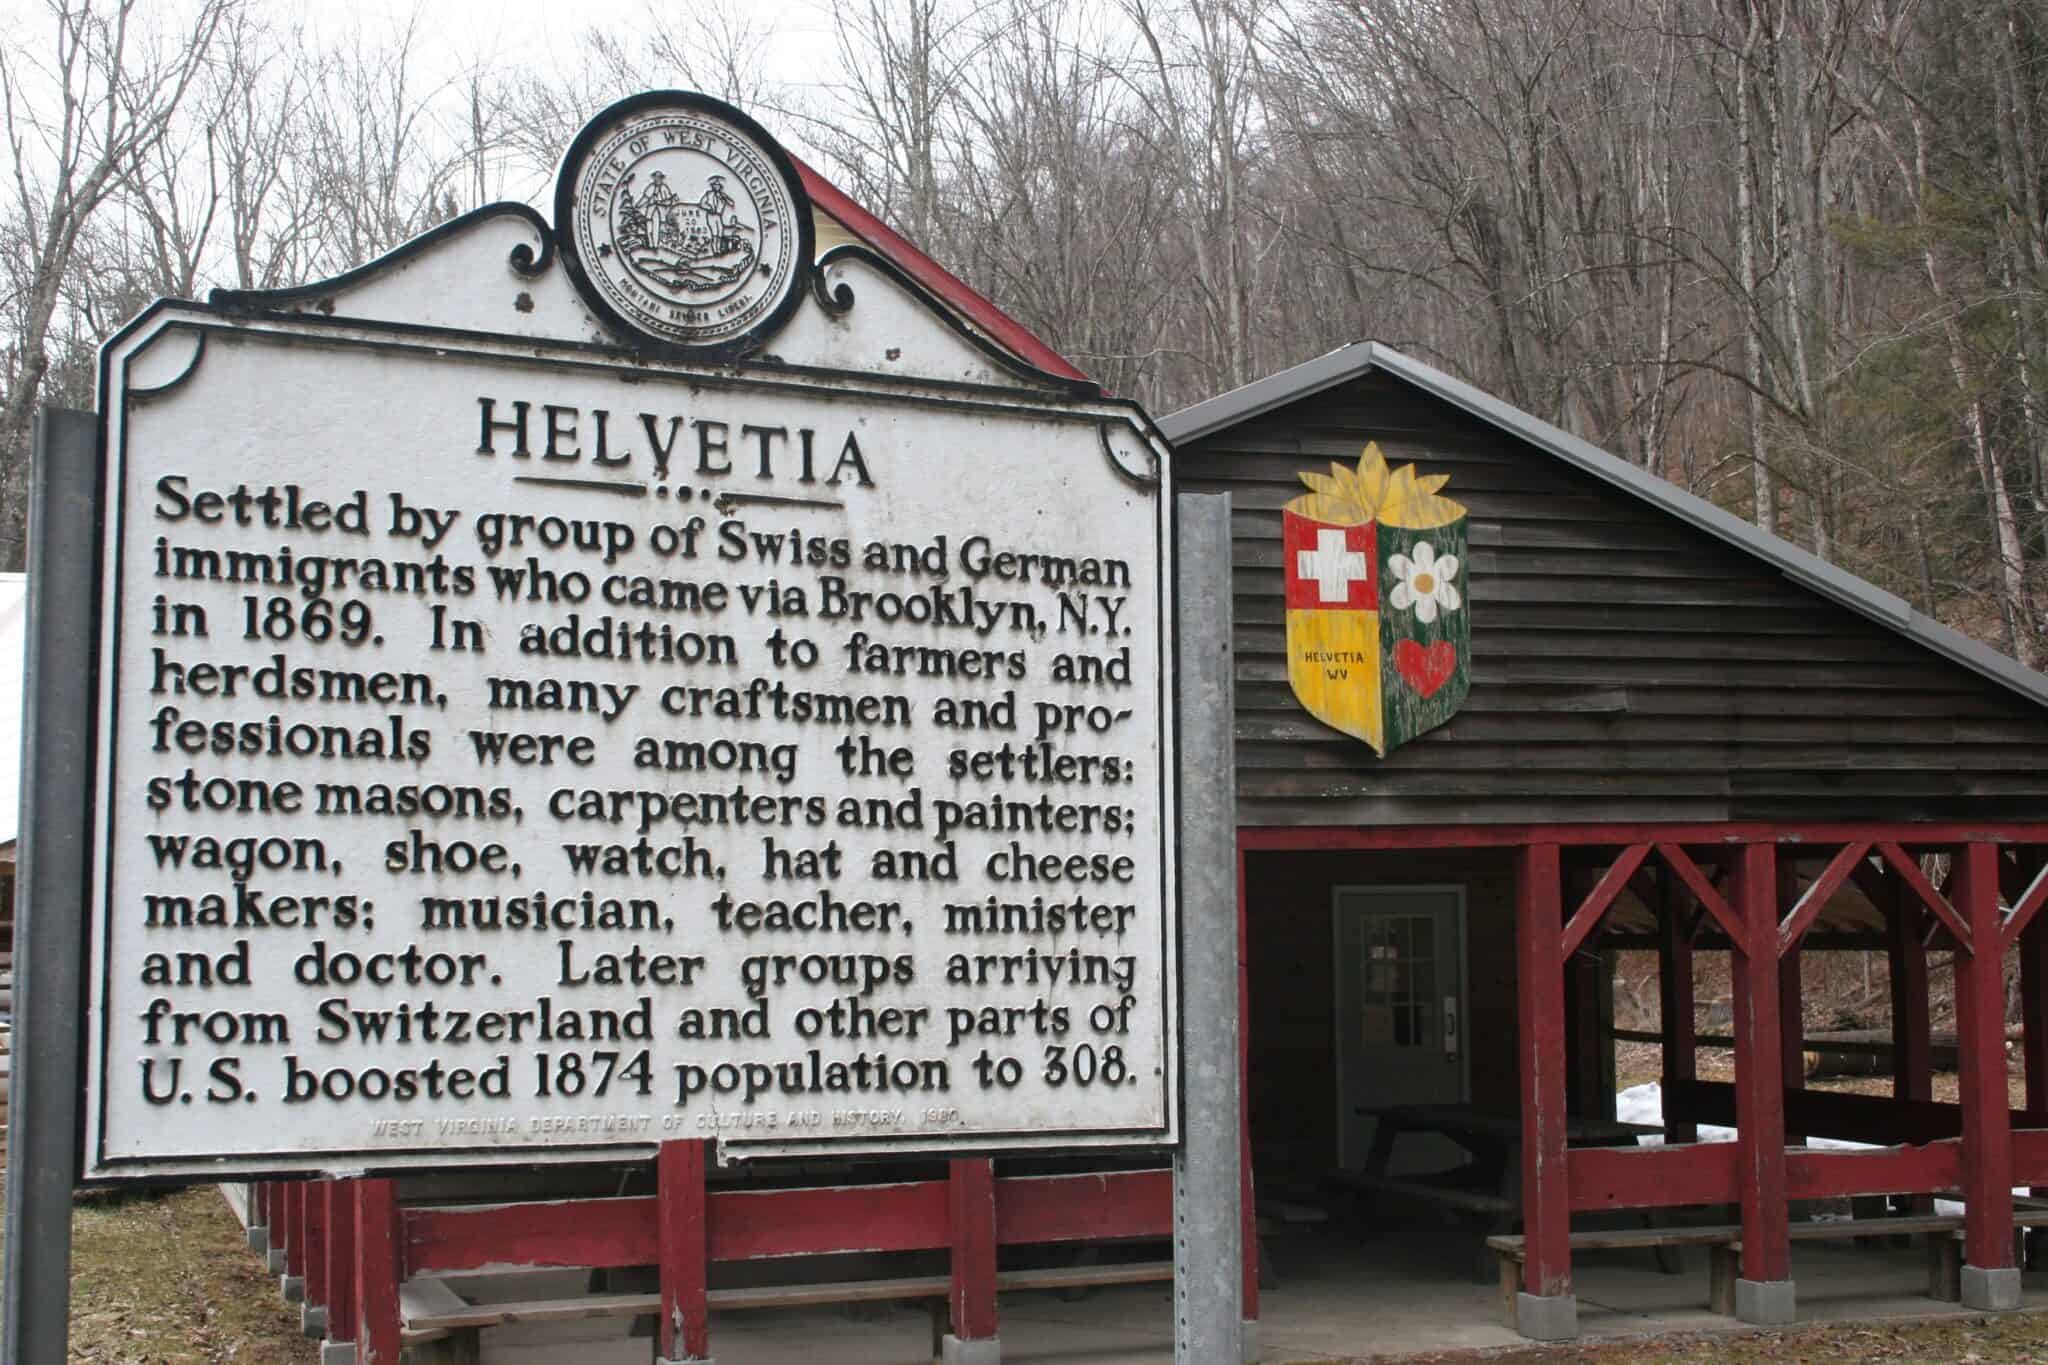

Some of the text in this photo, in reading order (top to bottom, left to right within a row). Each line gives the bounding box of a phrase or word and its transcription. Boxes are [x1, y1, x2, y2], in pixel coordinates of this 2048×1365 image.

[592, 156, 625, 217] STATE
[630, 135, 650, 155] OF
[663, 130, 717, 151] WEST
[477, 397, 875, 489] HELVETIA
[156, 475, 1131, 591] Settled by group of Swiss and German
[155, 536, 1131, 638] immigrants who came via Brooklyn, N.Y.
[153, 595, 1132, 687] in 1869. In addition to farmers and
[1304, 651, 1364, 664] HELVETIA
[1326, 668, 1348, 681] WV
[151, 647, 1133, 742] herdsmen, many craftsmen and pro-
[149, 706, 1133, 785] fessionals were among the settlers:
[147, 768, 1134, 843] stone masons, carpenters and painters;
[147, 829, 1135, 884] wagon, shoe, watch, hat and cheese
[144, 882, 1136, 937] makers; musician, teacher, minister
[141, 939, 1137, 998] and doctor. Later groups arriving
[141, 994, 1137, 1047] from Switzerland and other parts of
[283, 1055, 511, 1104] boosted
[535, 1049, 654, 1097] 1874
[675, 1049, 950, 1107] population
[972, 1050, 1023, 1090] to
[1044, 1043, 1137, 1088] 308.
[372, 1119, 423, 1137] WEST
[438, 1116, 519, 1136] VIRGINIA
[530, 1114, 651, 1134] DEPARTMENT
[663, 1114, 684, 1130] OF
[696, 1111, 777, 1130] CULTURE
[788, 1110, 823, 1128] AND
